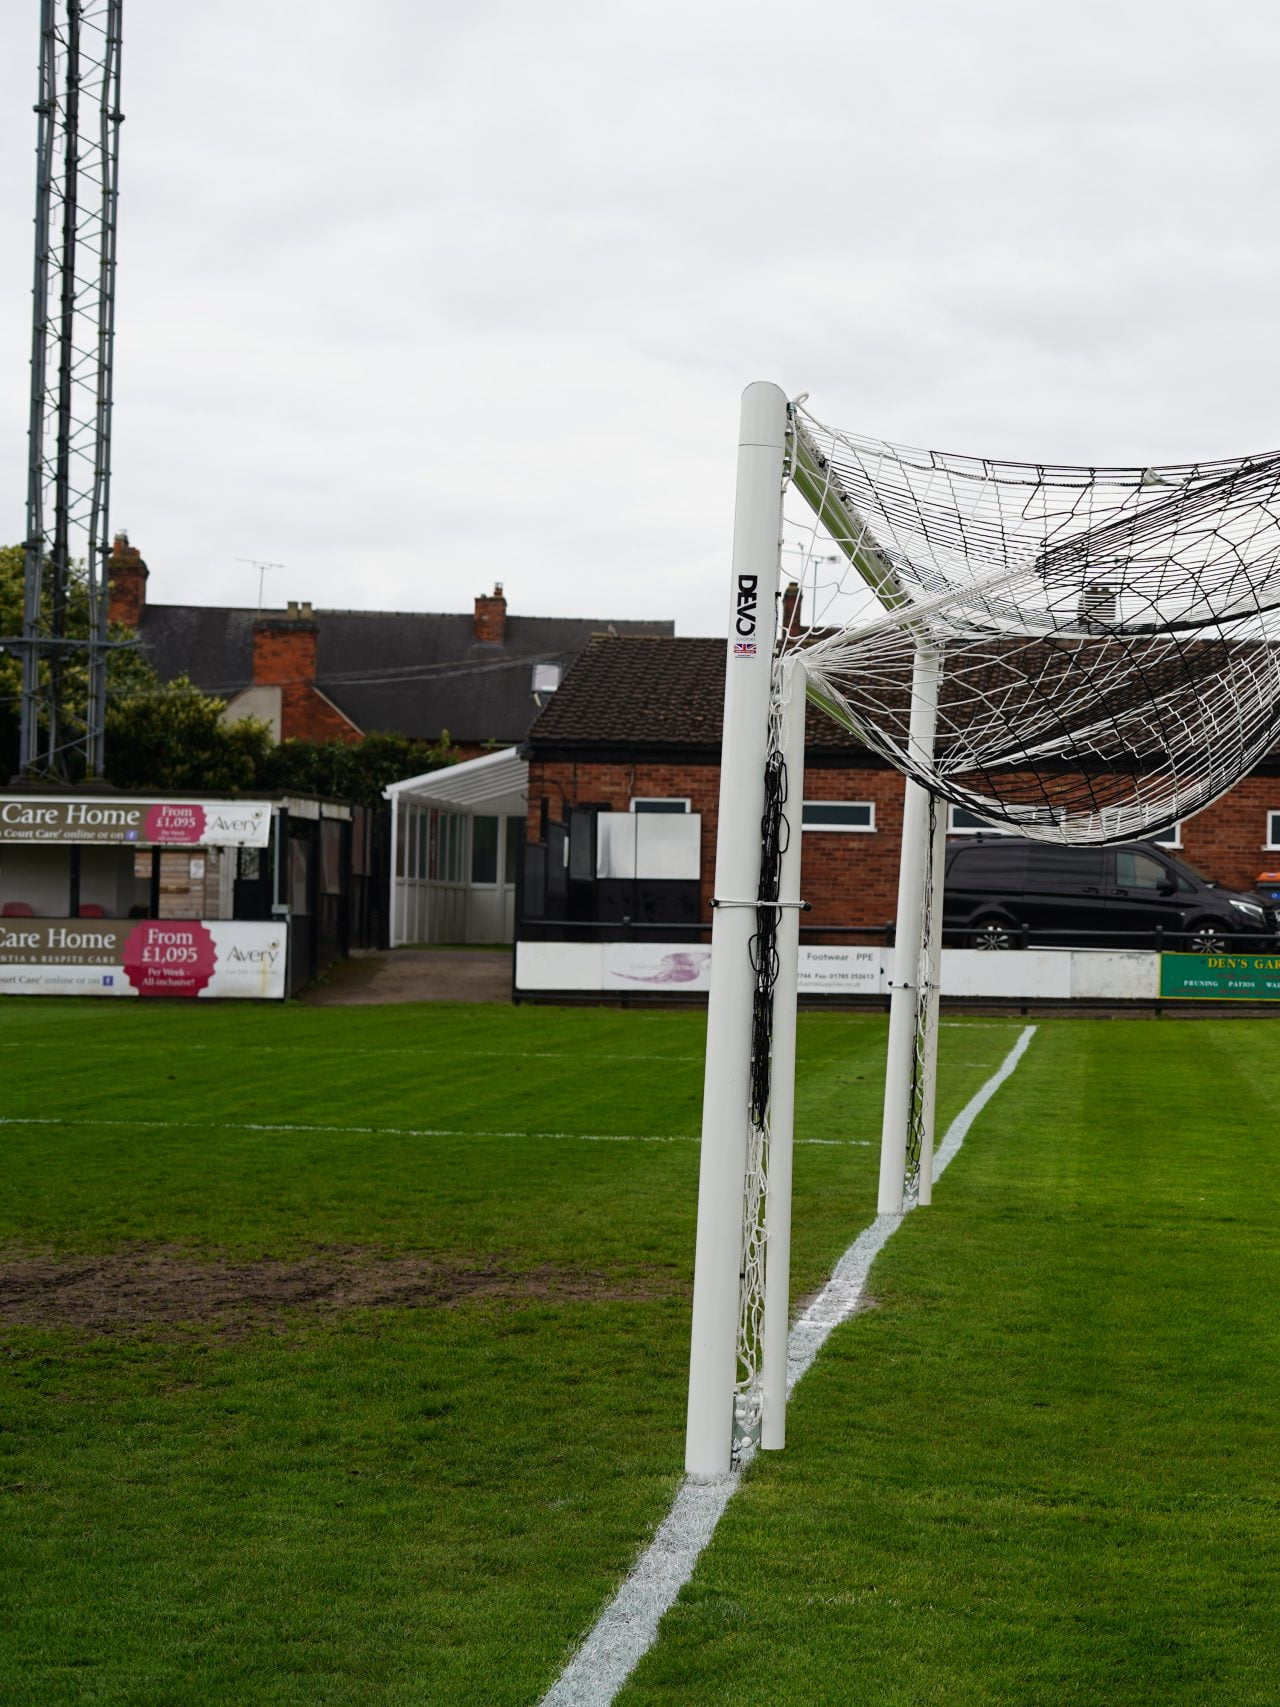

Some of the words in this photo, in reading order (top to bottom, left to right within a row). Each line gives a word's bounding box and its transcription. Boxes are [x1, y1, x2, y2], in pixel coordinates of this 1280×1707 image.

[735, 574, 758, 637] DEVO
[1, 803, 59, 824] Care
[65, 804, 141, 826] Home
[161, 806, 193, 817] From
[156, 817, 196, 828] £1,095
[210, 816, 262, 836] Avery
[0, 927, 40, 949] are
[47, 928, 117, 949] Home
[148, 928, 193, 945] From
[41, 955, 83, 964] RESPITE
[87, 956, 115, 964] CARE
[142, 947, 198, 964] £1,095
[227, 946, 280, 968] Avery
[806, 953, 849, 961] Footwear
[856, 953, 873, 961] PPE
[1207, 957, 1249, 969] DEN'S
[163, 968, 185, 976] Week
